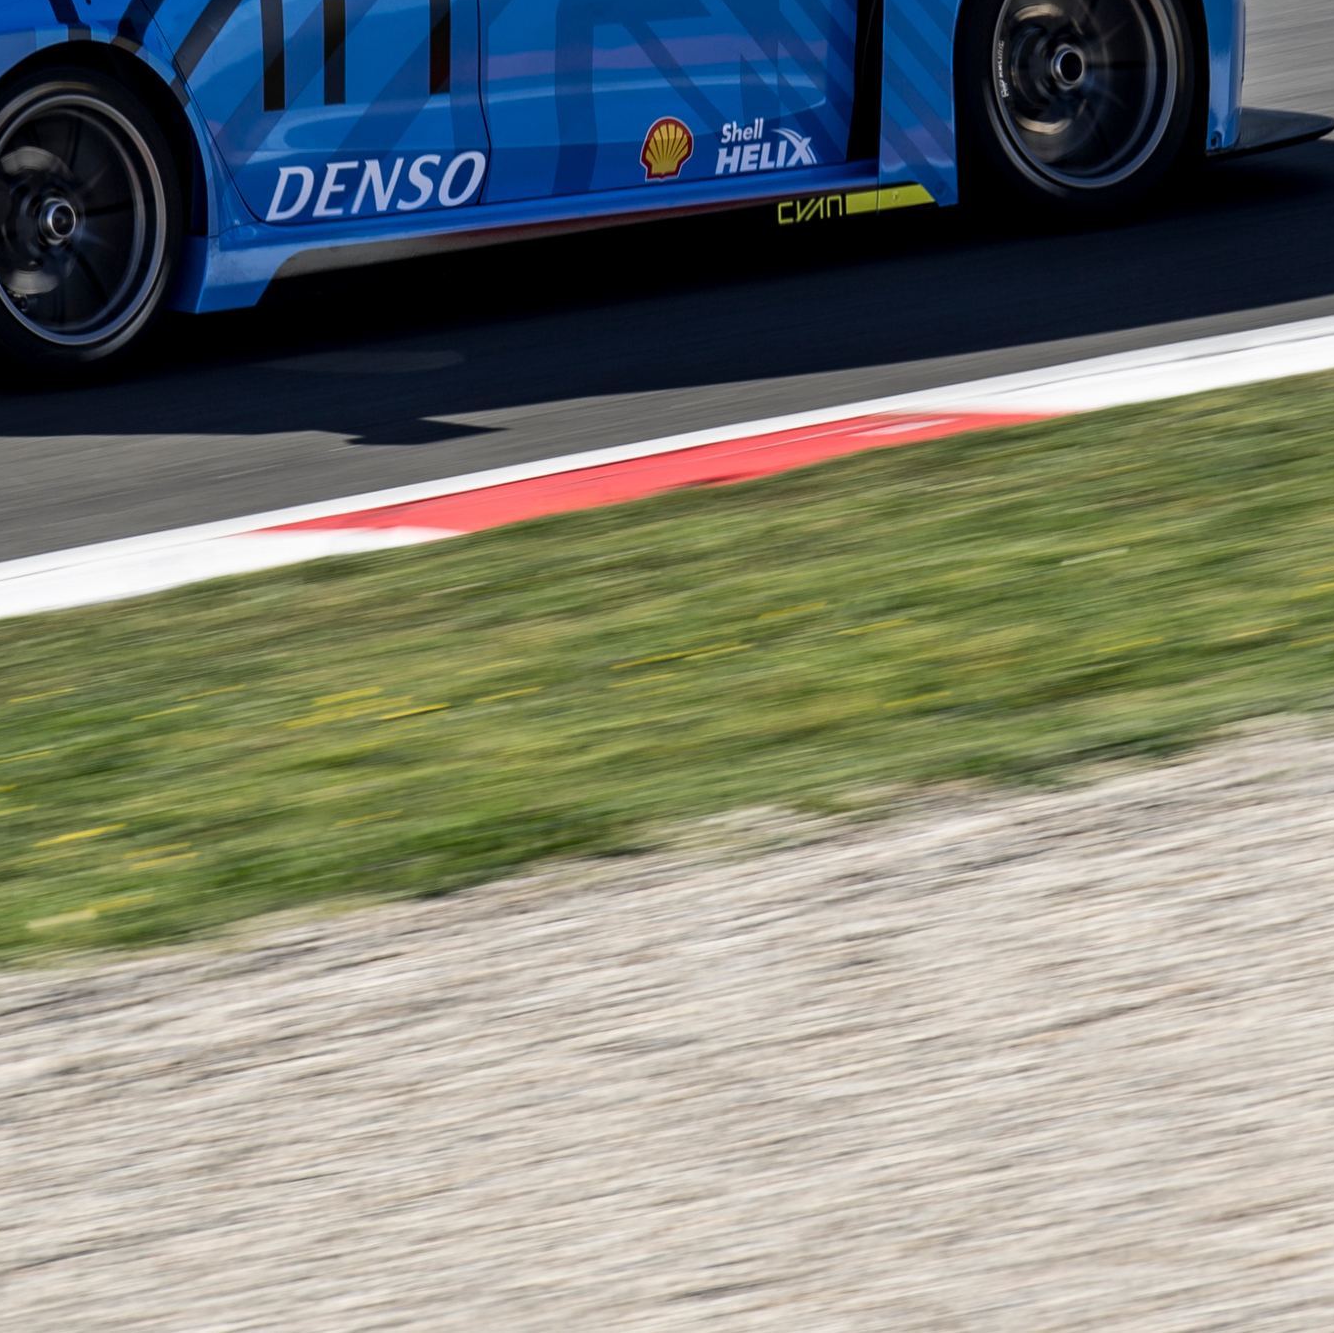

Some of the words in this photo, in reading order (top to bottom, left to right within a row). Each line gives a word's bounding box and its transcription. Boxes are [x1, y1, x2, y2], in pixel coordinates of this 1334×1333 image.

[720, 117, 764, 144] Shell
[715, 131, 818, 175] HELIX
[265, 150, 486, 222] DENSO
